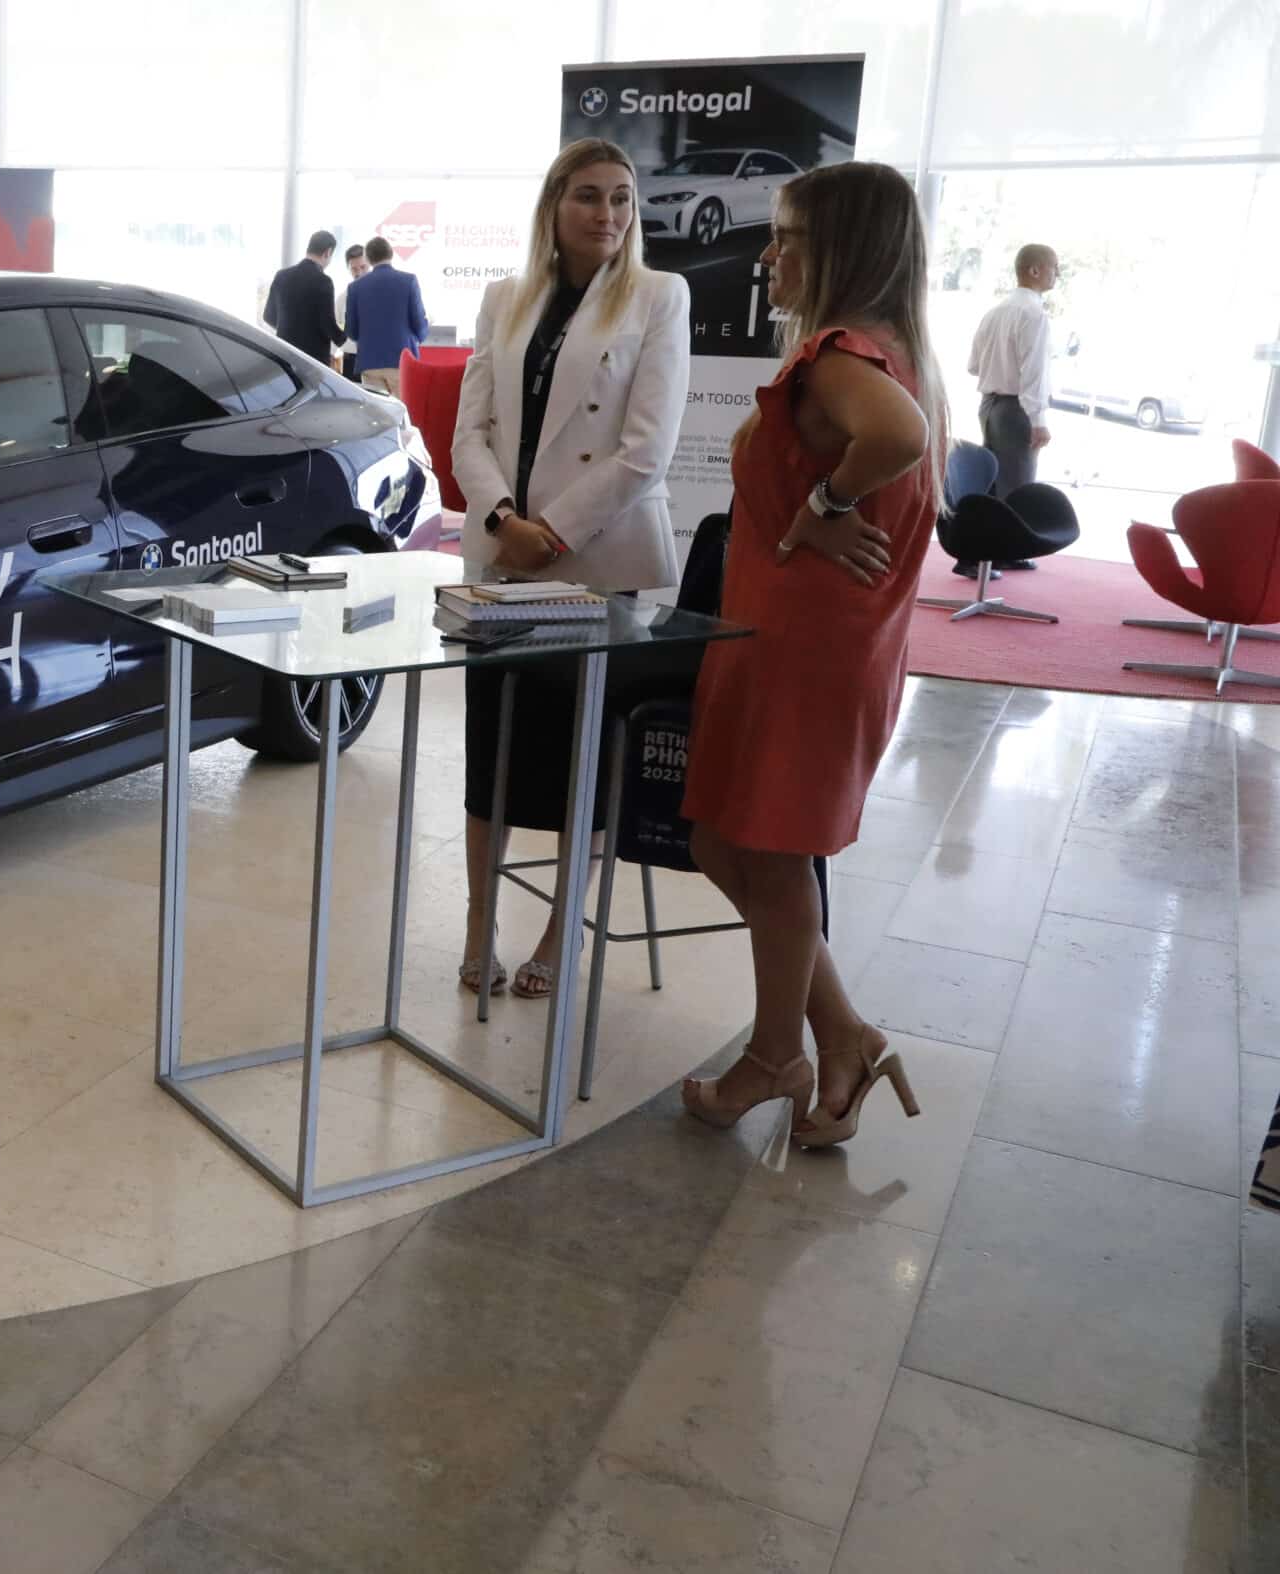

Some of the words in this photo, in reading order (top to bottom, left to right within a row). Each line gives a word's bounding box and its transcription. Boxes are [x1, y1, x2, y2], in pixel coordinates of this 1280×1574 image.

[620, 85, 752, 118] Santogal
[444, 223, 519, 236] EXECUTIVE
[444, 237, 520, 248] EDUCATION
[442, 266, 481, 277] OPEN
[707, 393, 752, 406] TODOS
[707, 455, 731, 464] BMW
[171, 521, 263, 567] Santogal
[644, 731, 688, 749] RETH
[642, 745, 688, 768] PHA
[641, 766, 681, 783] 2023
